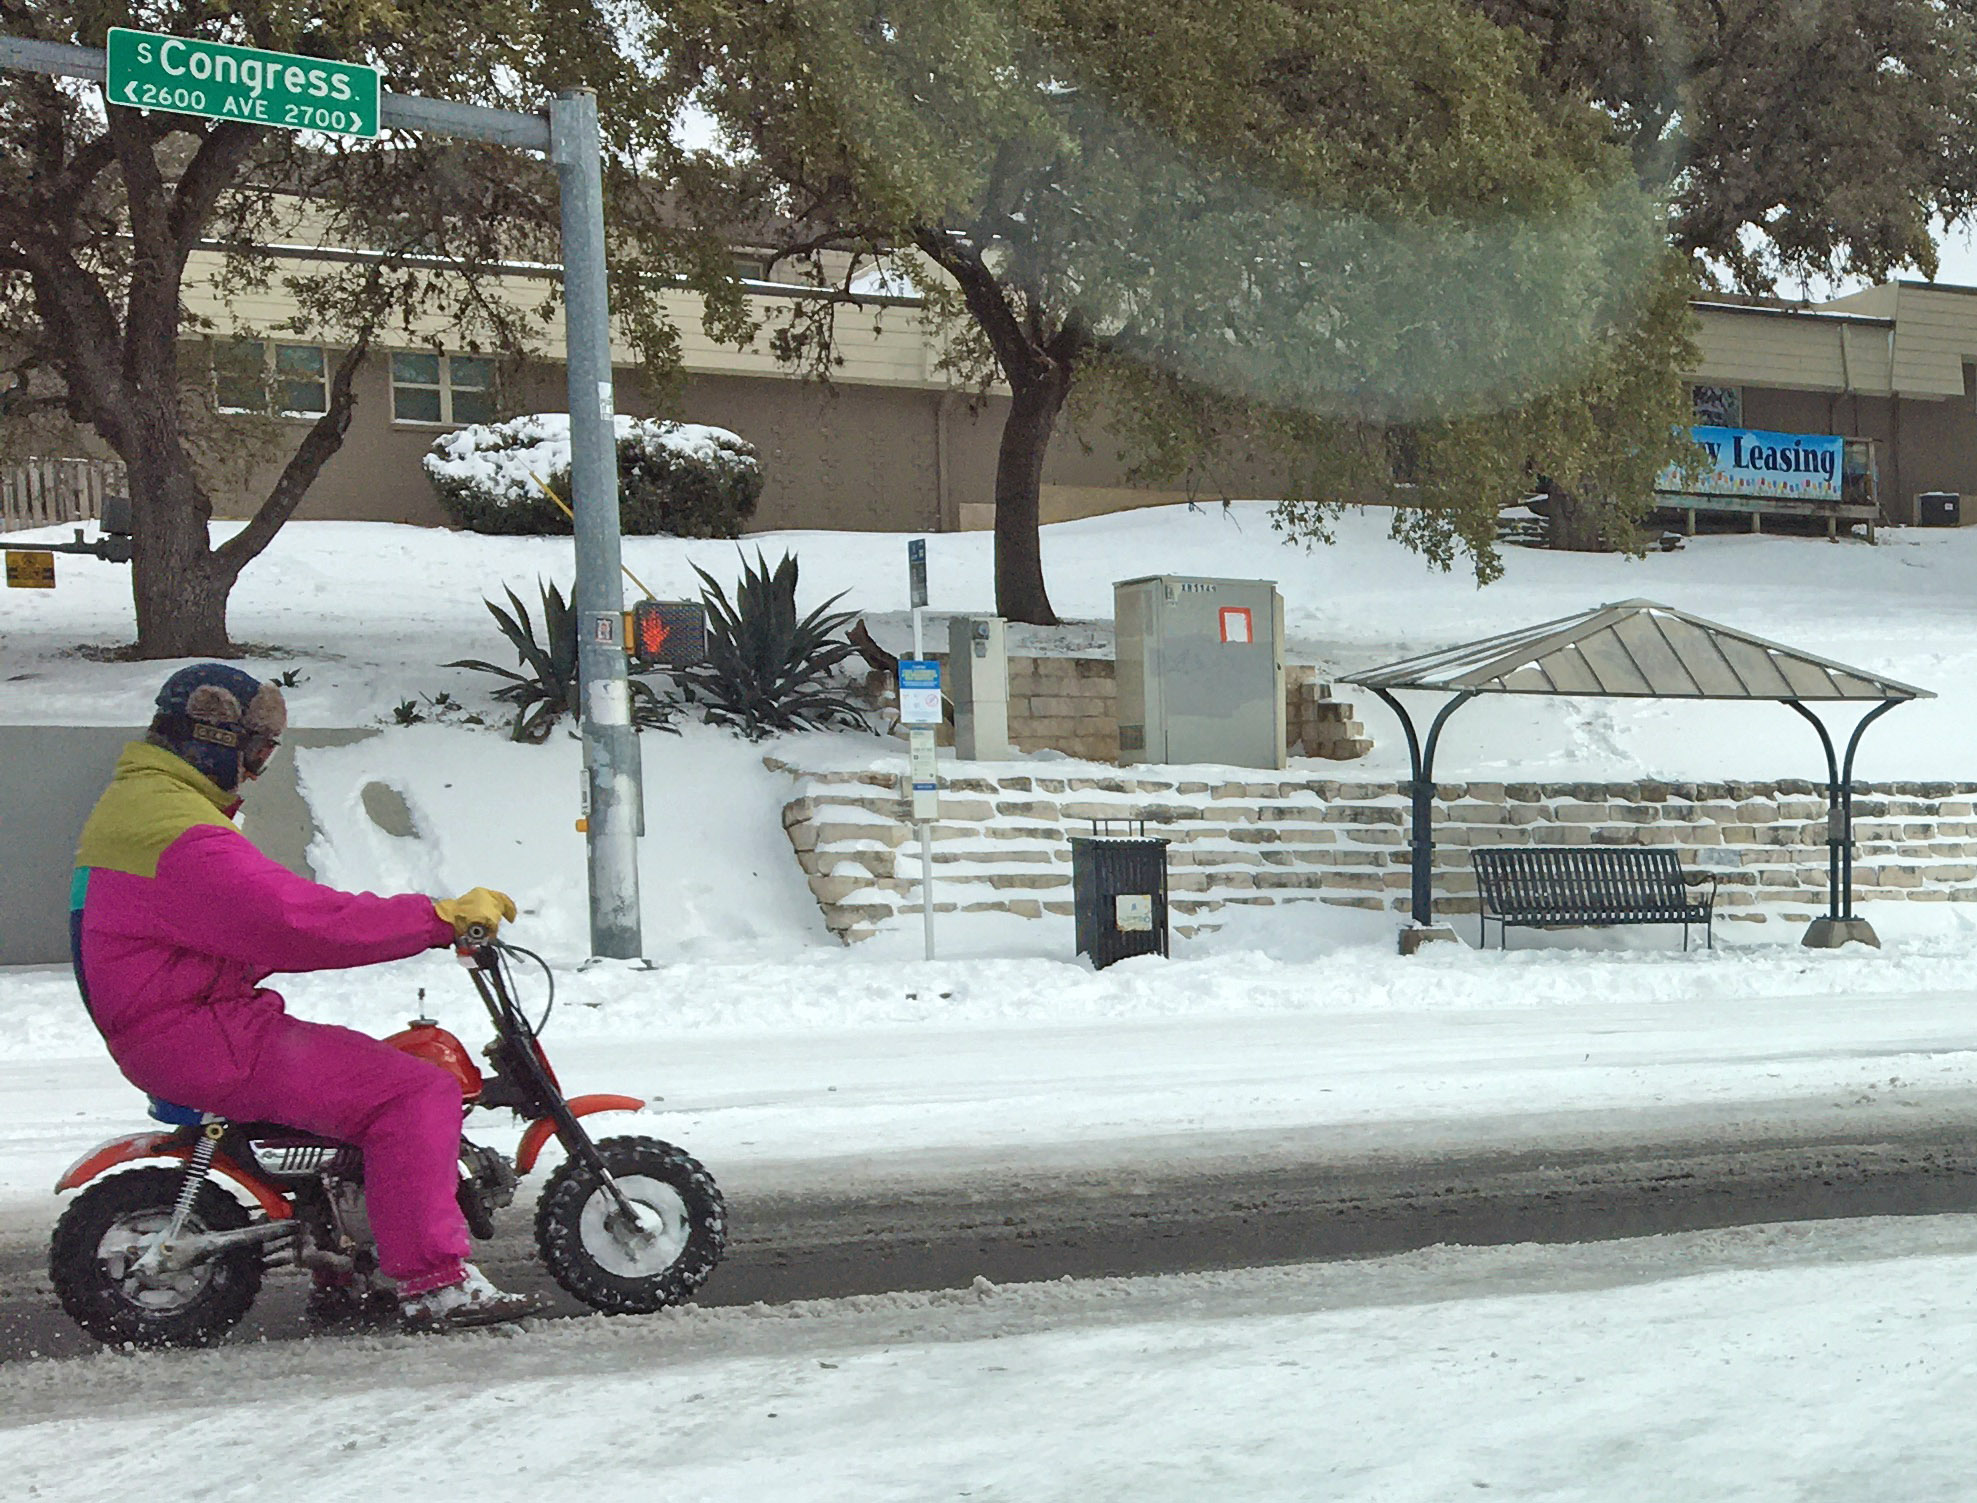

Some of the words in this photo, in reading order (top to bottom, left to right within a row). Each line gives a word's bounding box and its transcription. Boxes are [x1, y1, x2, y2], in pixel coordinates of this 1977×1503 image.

[137, 43, 153, 64] S
[160, 40, 351, 101] Congress
[142, 84, 206, 110] 2600
[222, 95, 268, 119] AVE
[285, 104, 346, 129] 2700
[1732, 436, 1835, 482] Leasing
